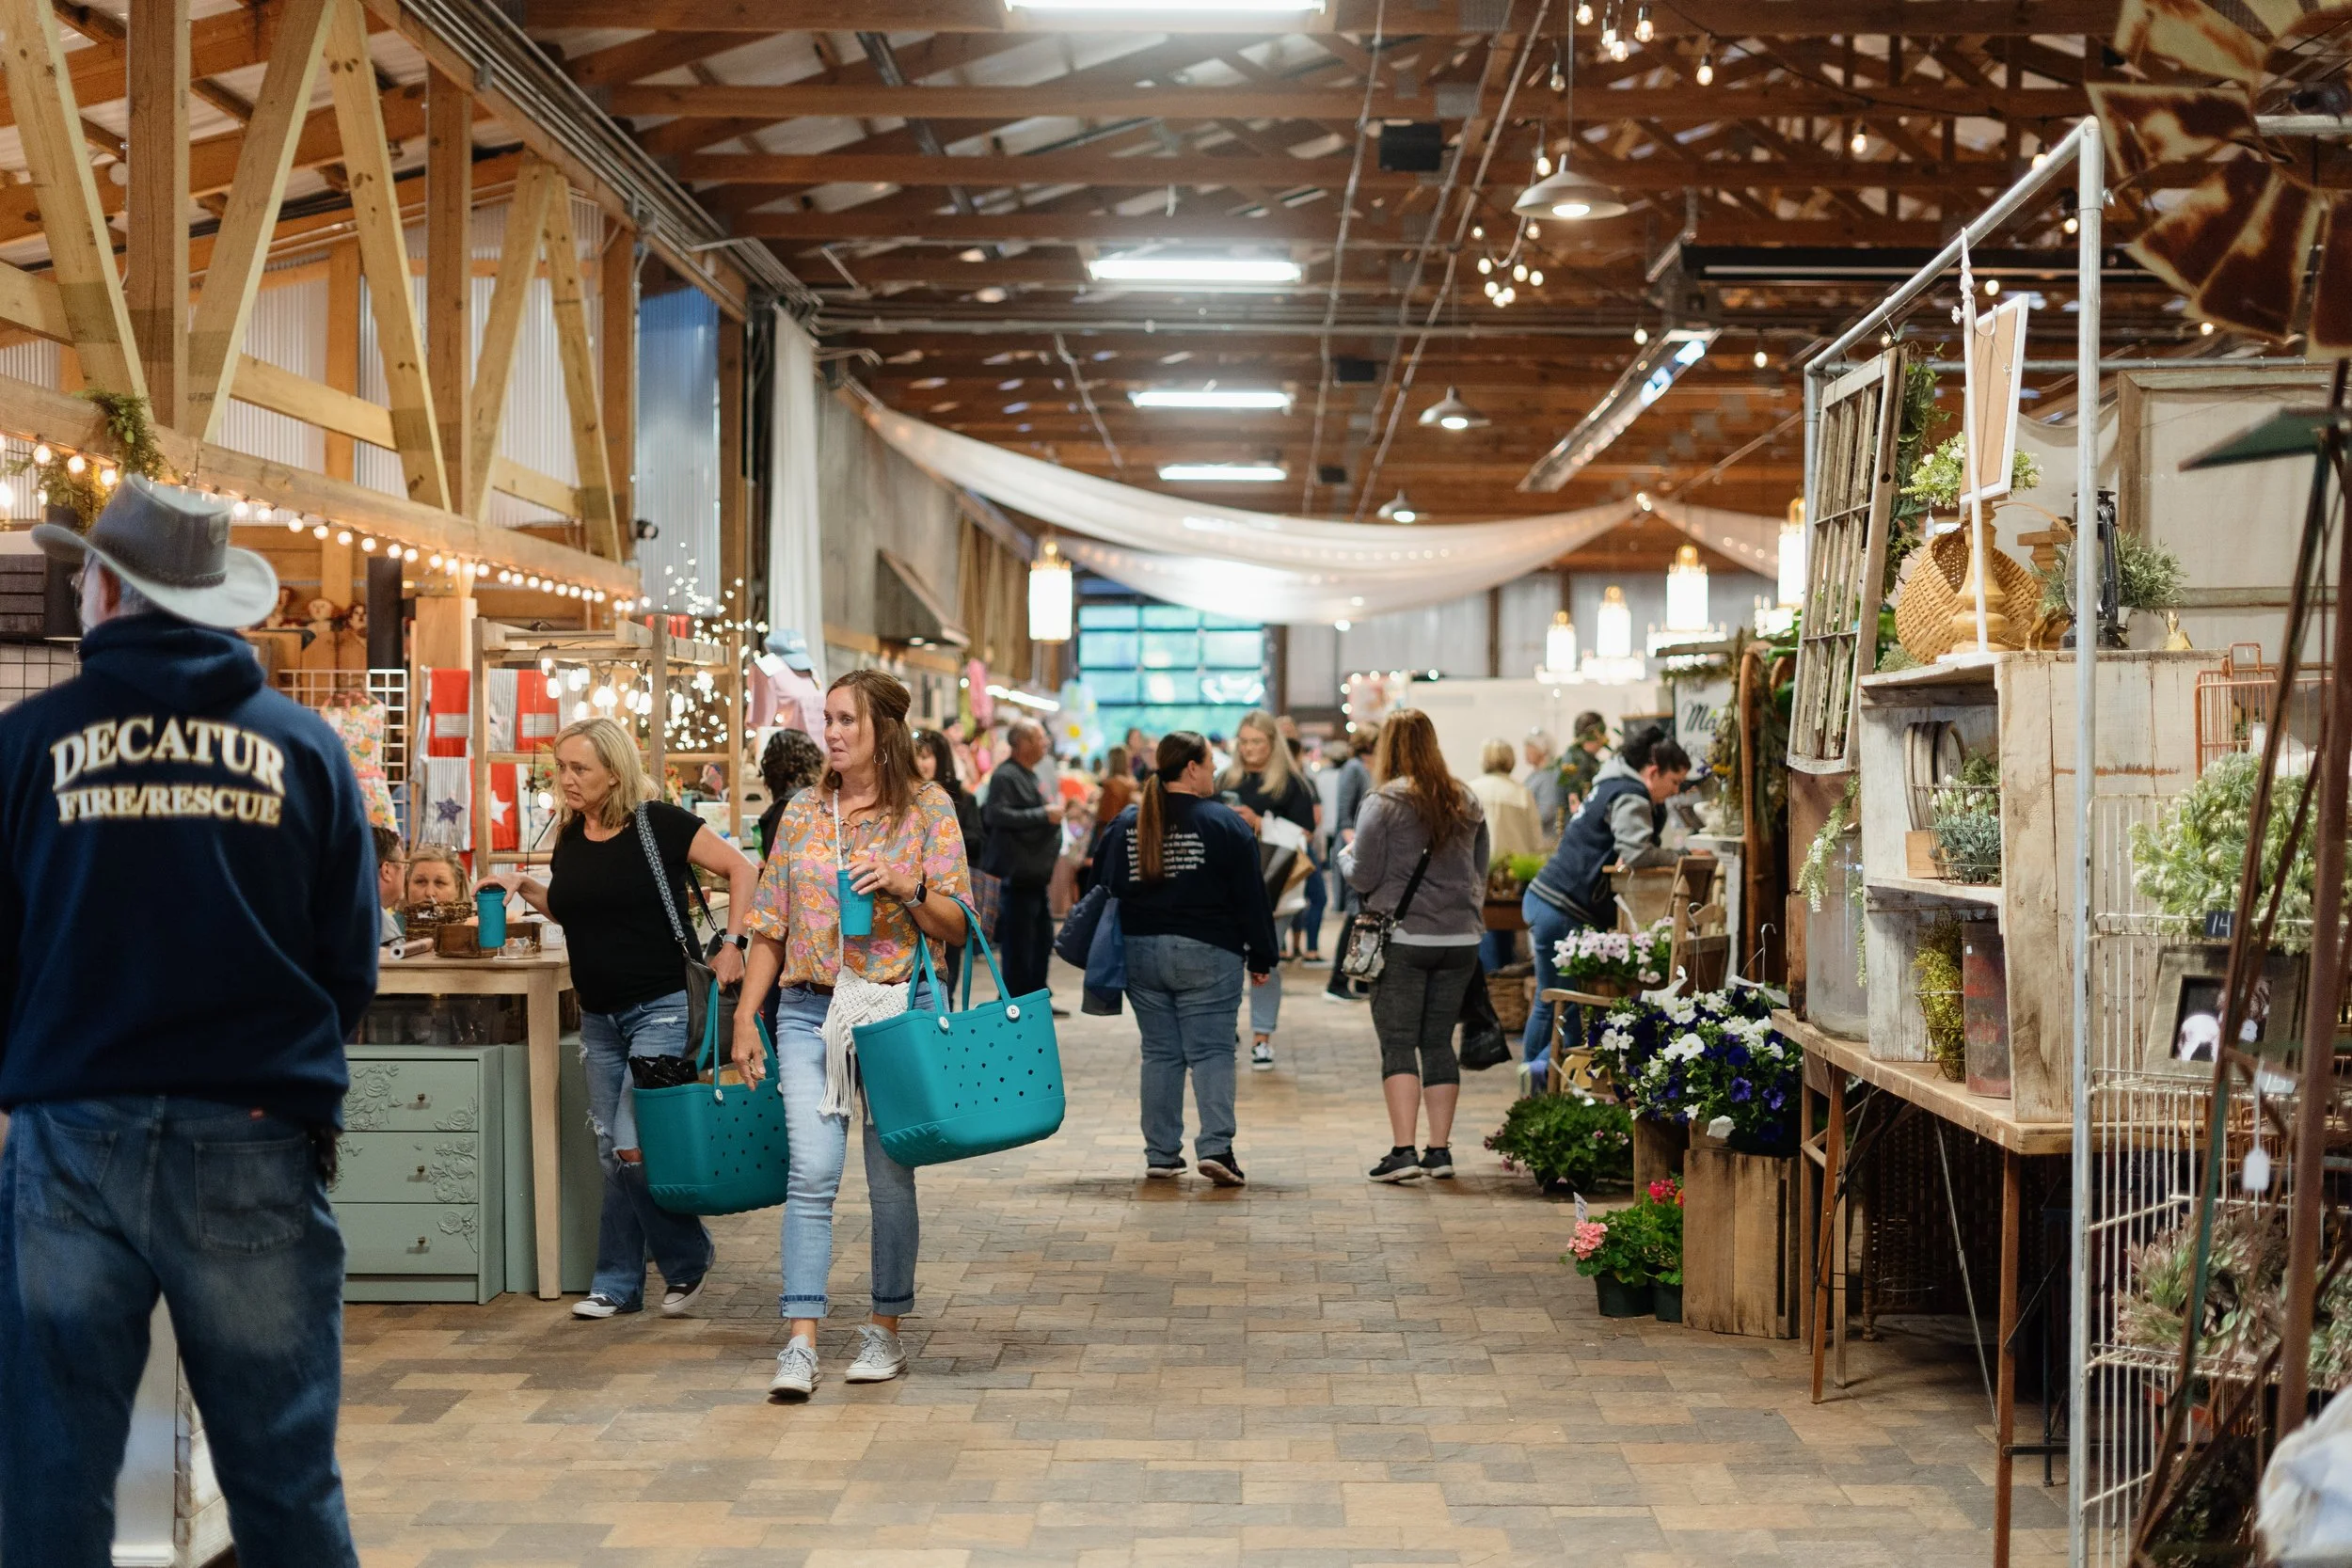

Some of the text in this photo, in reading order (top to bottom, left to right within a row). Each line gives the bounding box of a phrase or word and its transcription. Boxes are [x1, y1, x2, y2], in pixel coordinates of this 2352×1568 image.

[50, 715, 285, 796] DECATUR
[56, 783, 282, 826] FIRE/RESCUE
[2212, 913, 2231, 938] 14
